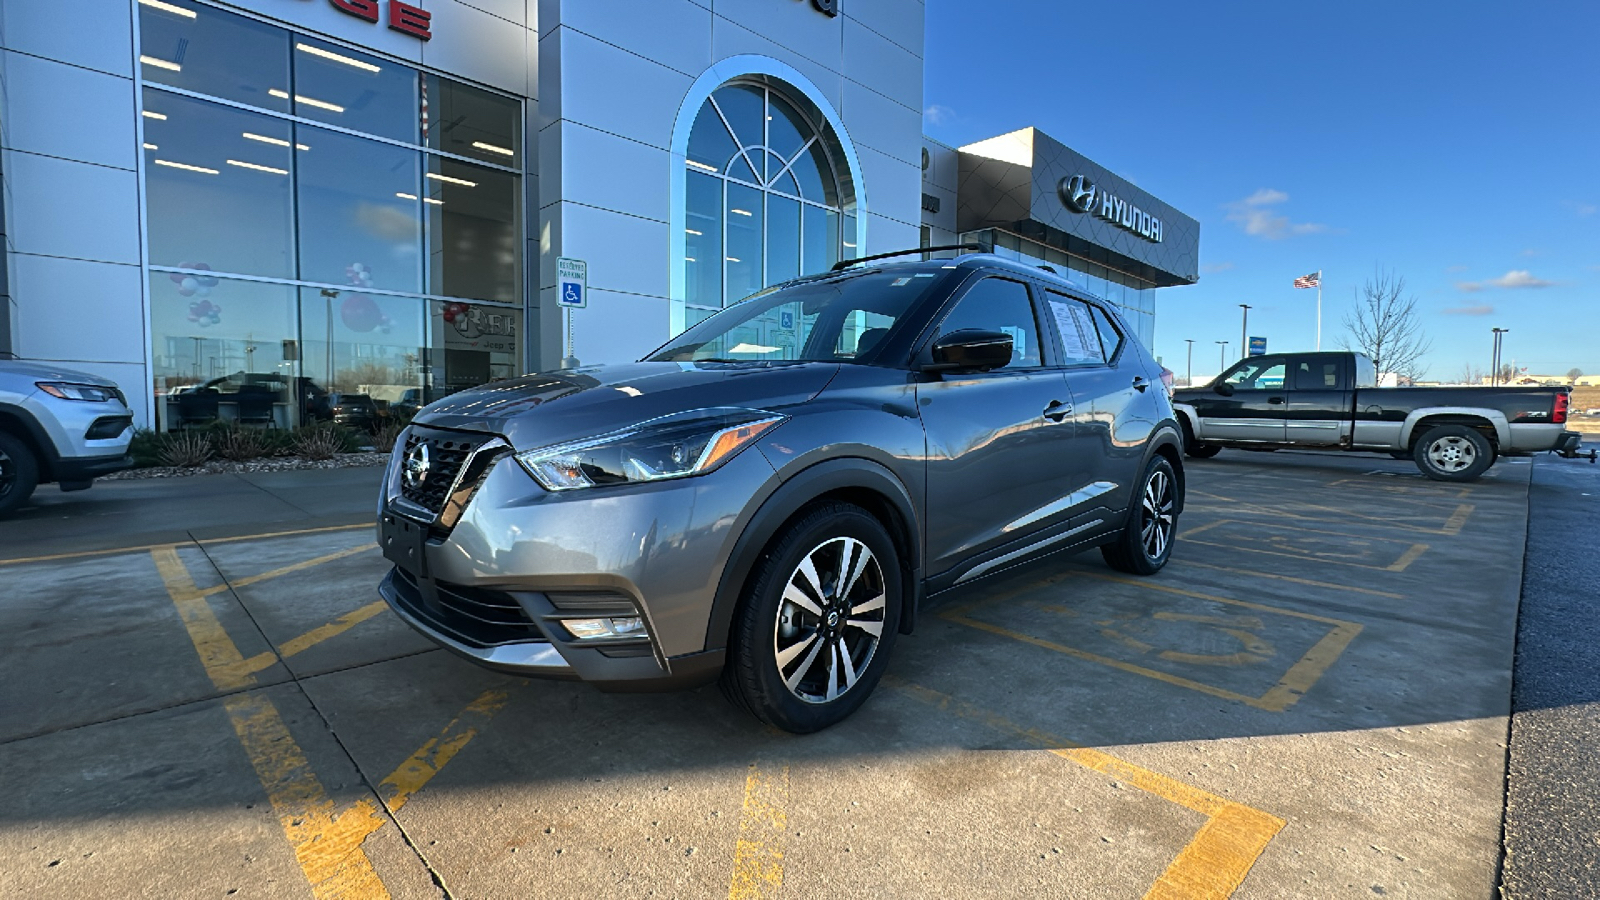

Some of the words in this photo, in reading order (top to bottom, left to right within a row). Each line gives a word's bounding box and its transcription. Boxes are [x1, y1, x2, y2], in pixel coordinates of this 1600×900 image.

[1101, 190, 1163, 243] HYUNDAI
[560, 261, 584, 272] RESERVED
[560, 269, 584, 280] PARKING
